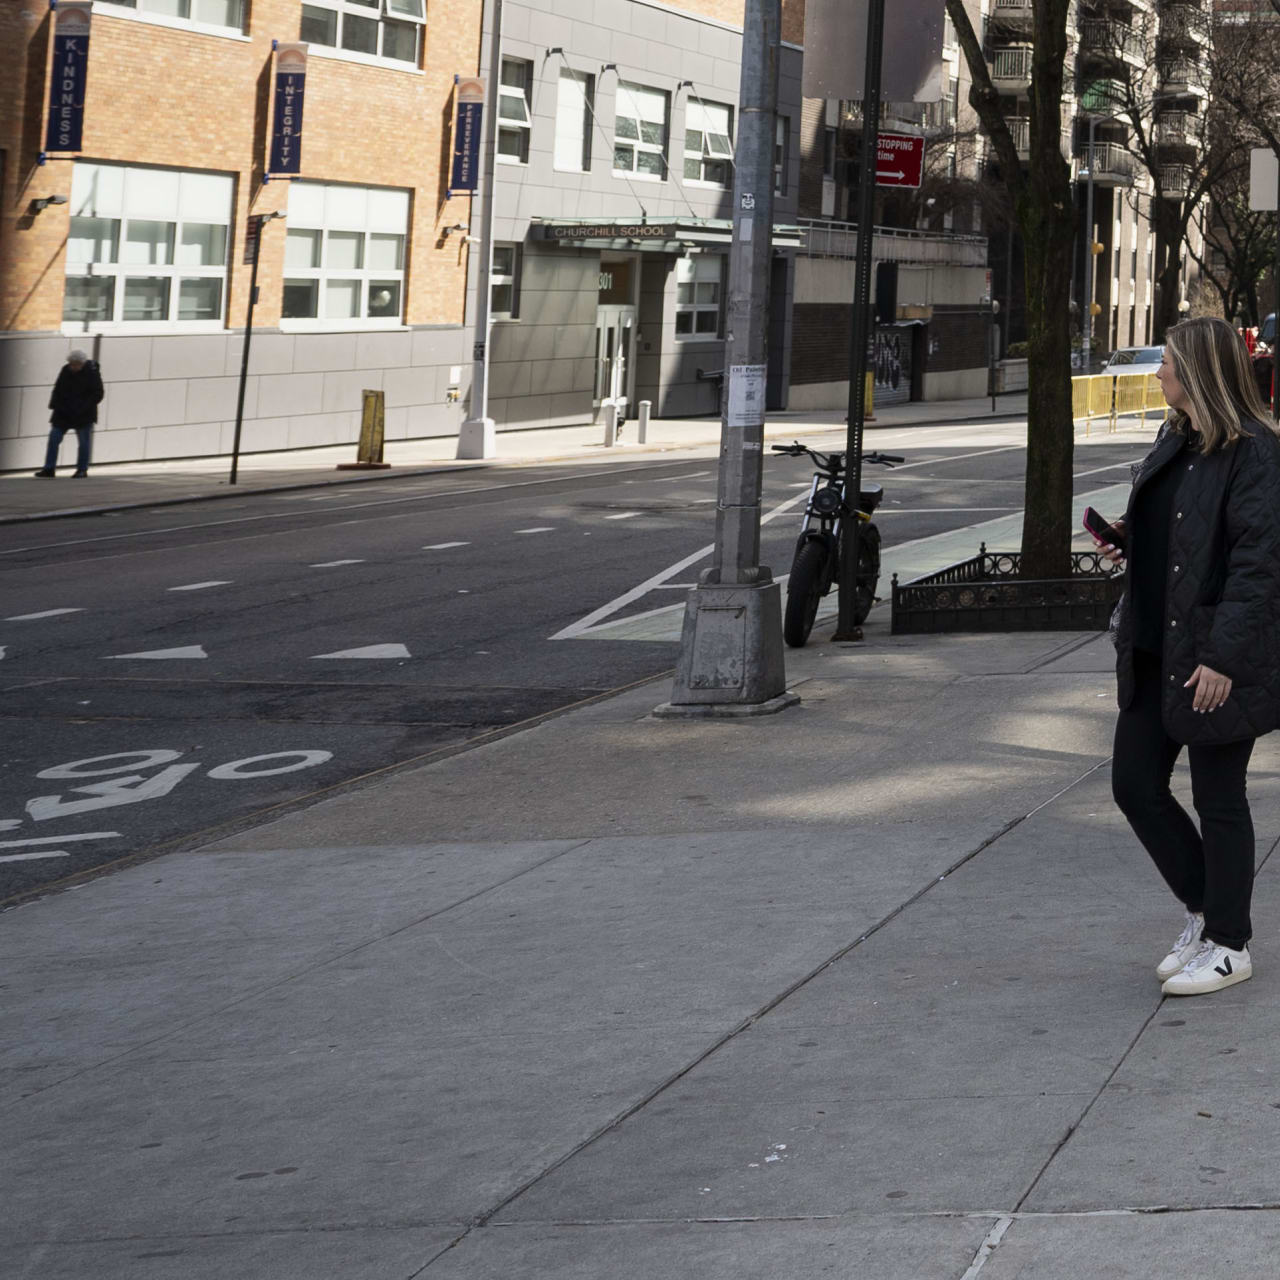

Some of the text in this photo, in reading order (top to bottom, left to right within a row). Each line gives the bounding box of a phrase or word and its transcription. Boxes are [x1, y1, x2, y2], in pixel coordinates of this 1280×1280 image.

[59, 39, 77, 146] KINDNESS
[281, 76, 295, 166] INTEGRITY
[461, 104, 473, 183] PERSEVERANCE
[877, 139, 914, 151] STOPPING
[877, 150, 895, 161] time
[555, 226, 667, 238] CHURCHILL SCHOOL
[598, 272, 613, 290] 301
